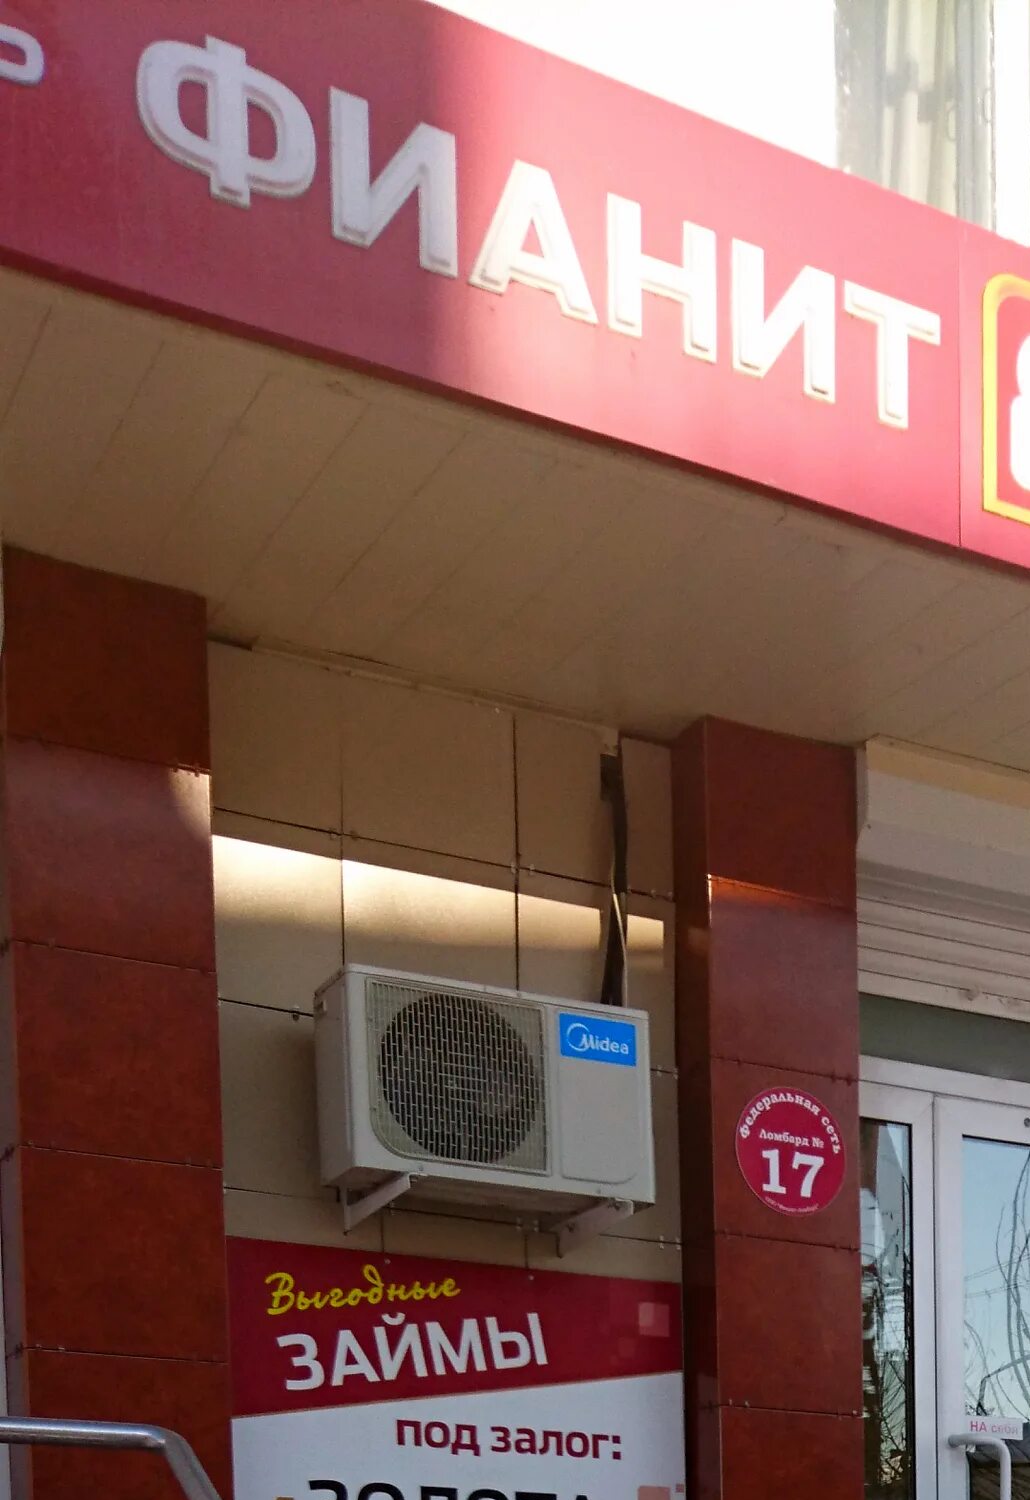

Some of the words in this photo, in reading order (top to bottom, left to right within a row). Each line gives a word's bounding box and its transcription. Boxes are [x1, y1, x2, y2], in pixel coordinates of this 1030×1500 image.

[136, 36, 941, 430] ФИАНИТ
[575, 1030, 629, 1055] Midea
[739, 1092, 821, 1139] Федеральная
[821, 1116, 841, 1154] сеть
[759, 1129, 810, 1147] Ломбард
[762, 1148, 825, 1198] 17
[264, 1264, 461, 1315] Выгодные
[276, 1312, 548, 1391] ЗАЙМЫ
[396, 1418, 481, 1457] под
[491, 1424, 622, 1460] залог:
[970, 1420, 988, 1432] НА
